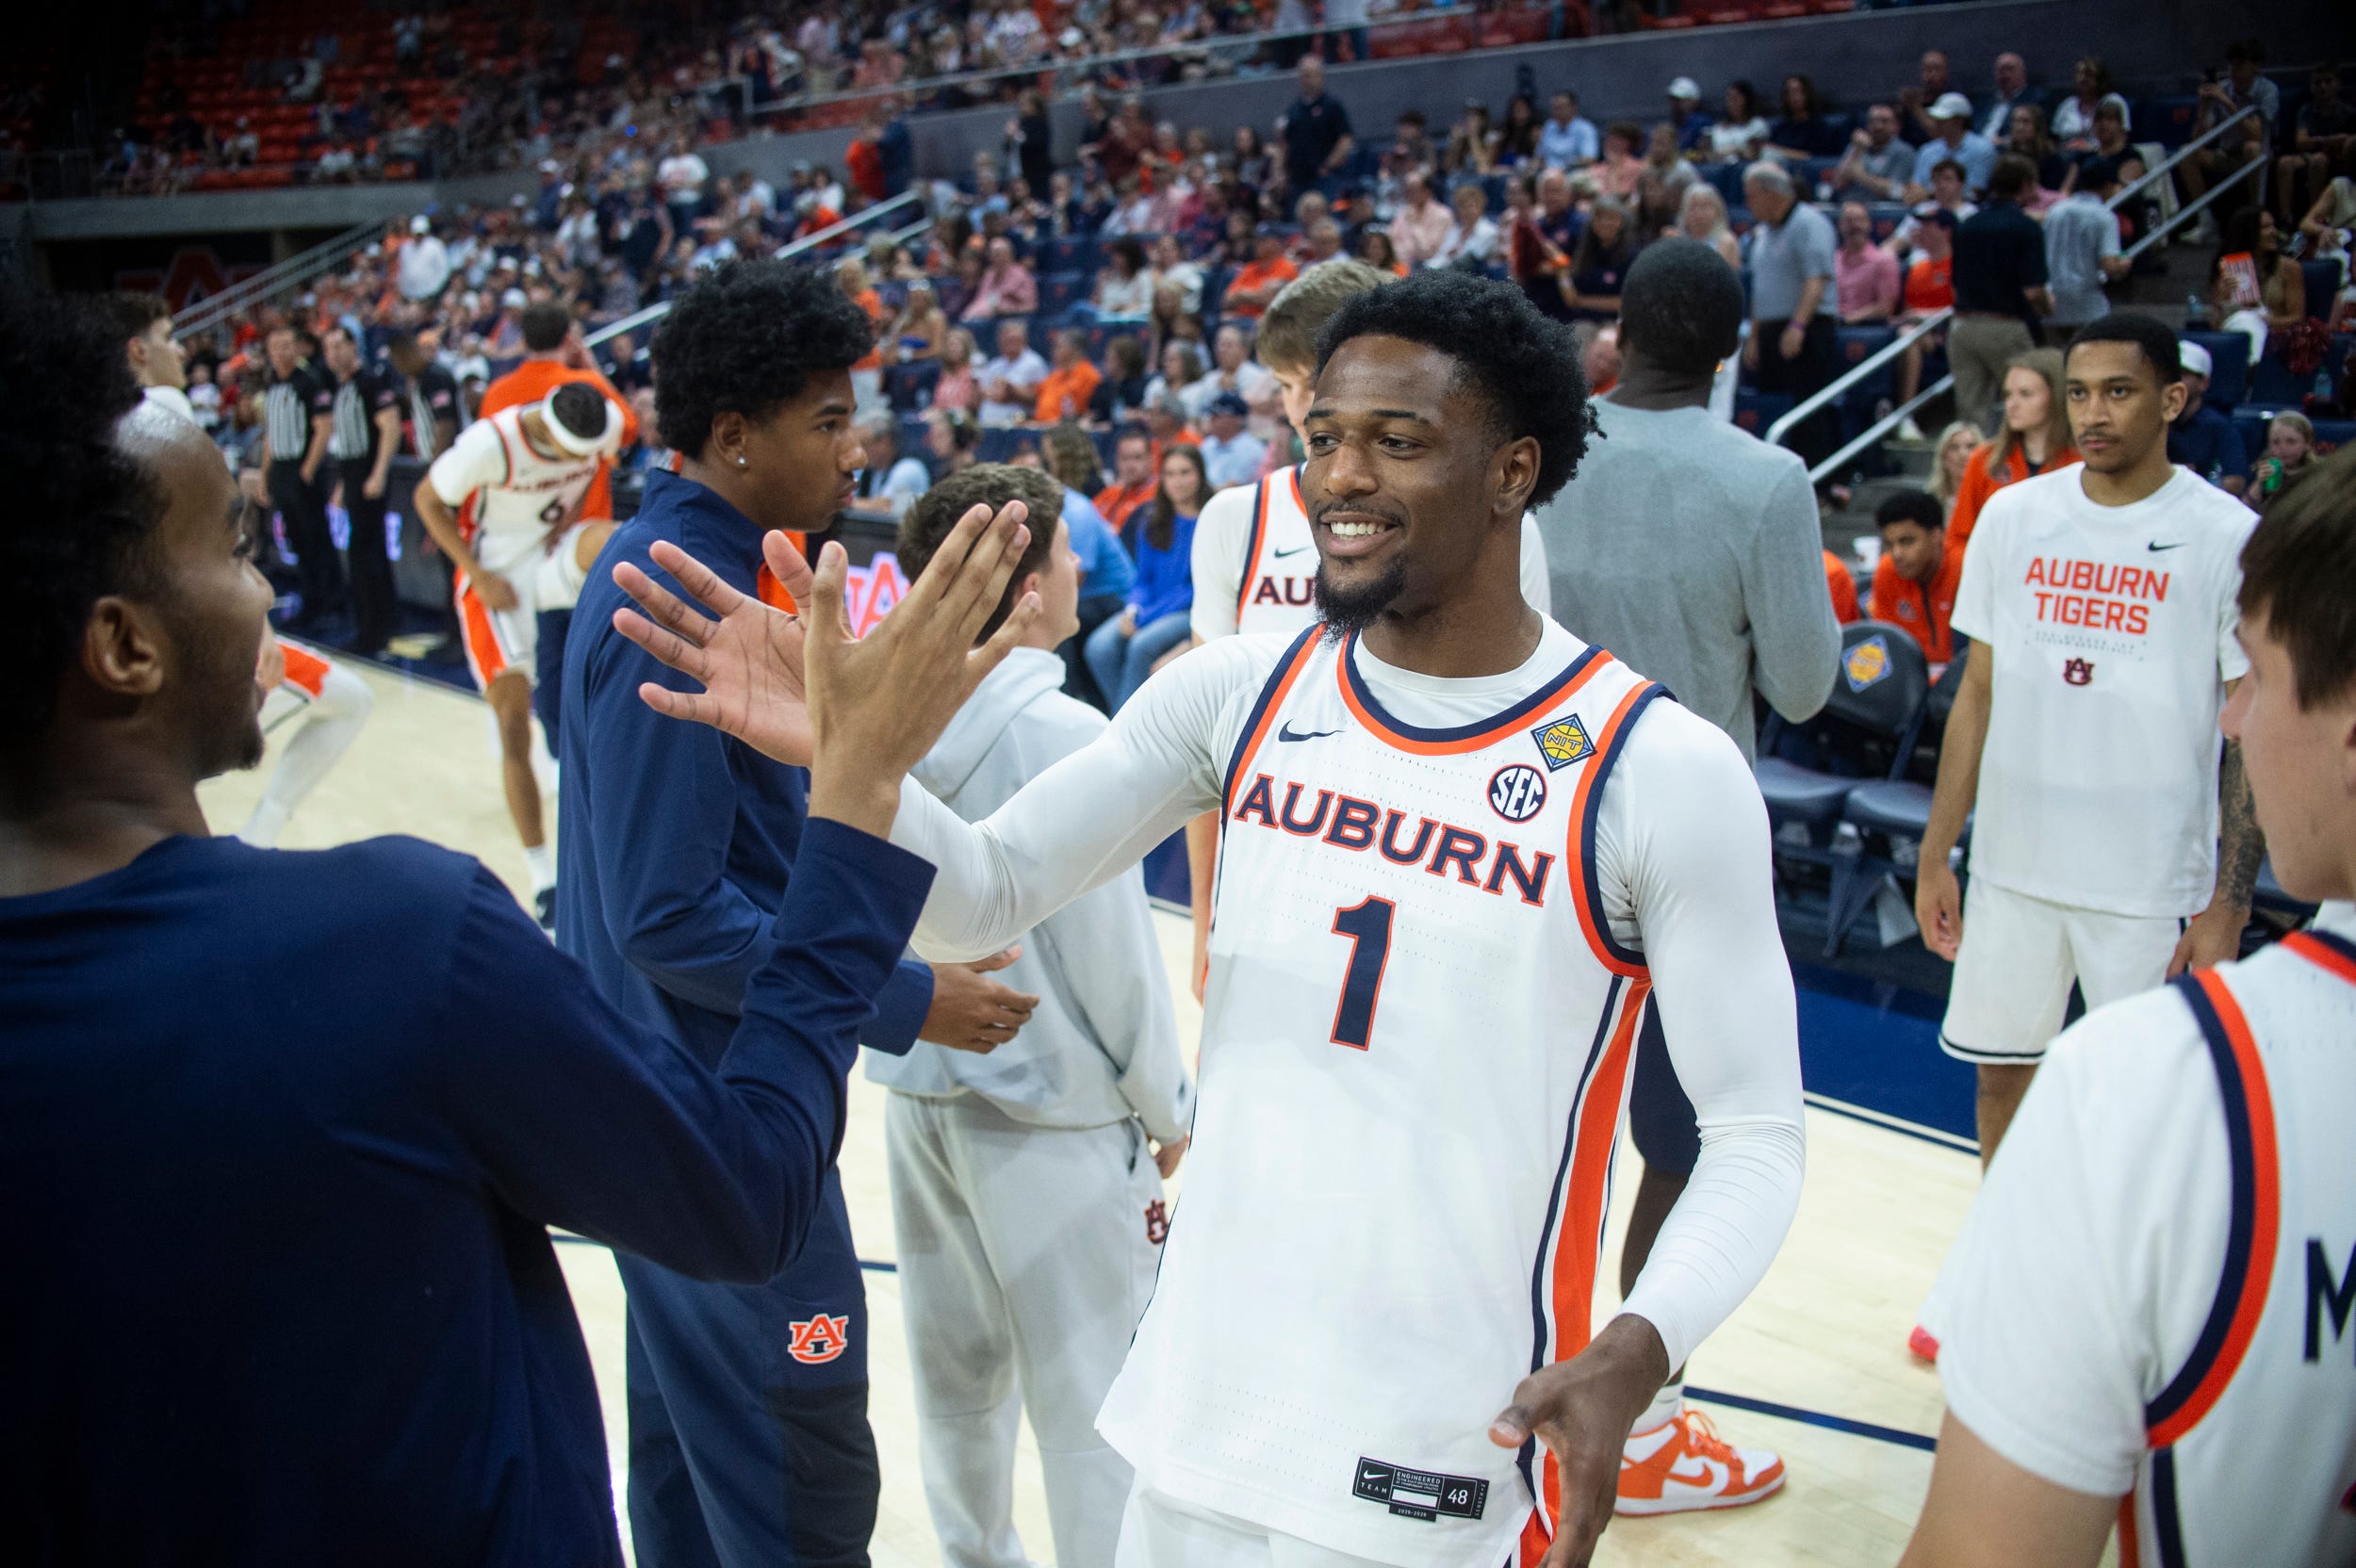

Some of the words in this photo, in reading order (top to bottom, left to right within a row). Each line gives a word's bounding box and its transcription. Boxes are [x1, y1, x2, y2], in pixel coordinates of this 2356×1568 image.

[2024, 557, 2170, 602] AUBURN
[2034, 592, 2150, 635] TIGERS
[1546, 732, 1582, 750] NIT
[1491, 766, 1544, 820] SEC
[1234, 773, 1555, 907] AUBURN
[1330, 894, 1396, 1052] 1
[1361, 1481, 1387, 1494] TEAM
[1397, 1471, 1441, 1485] ENGINEERED
[1448, 1488, 1468, 1505] 48
